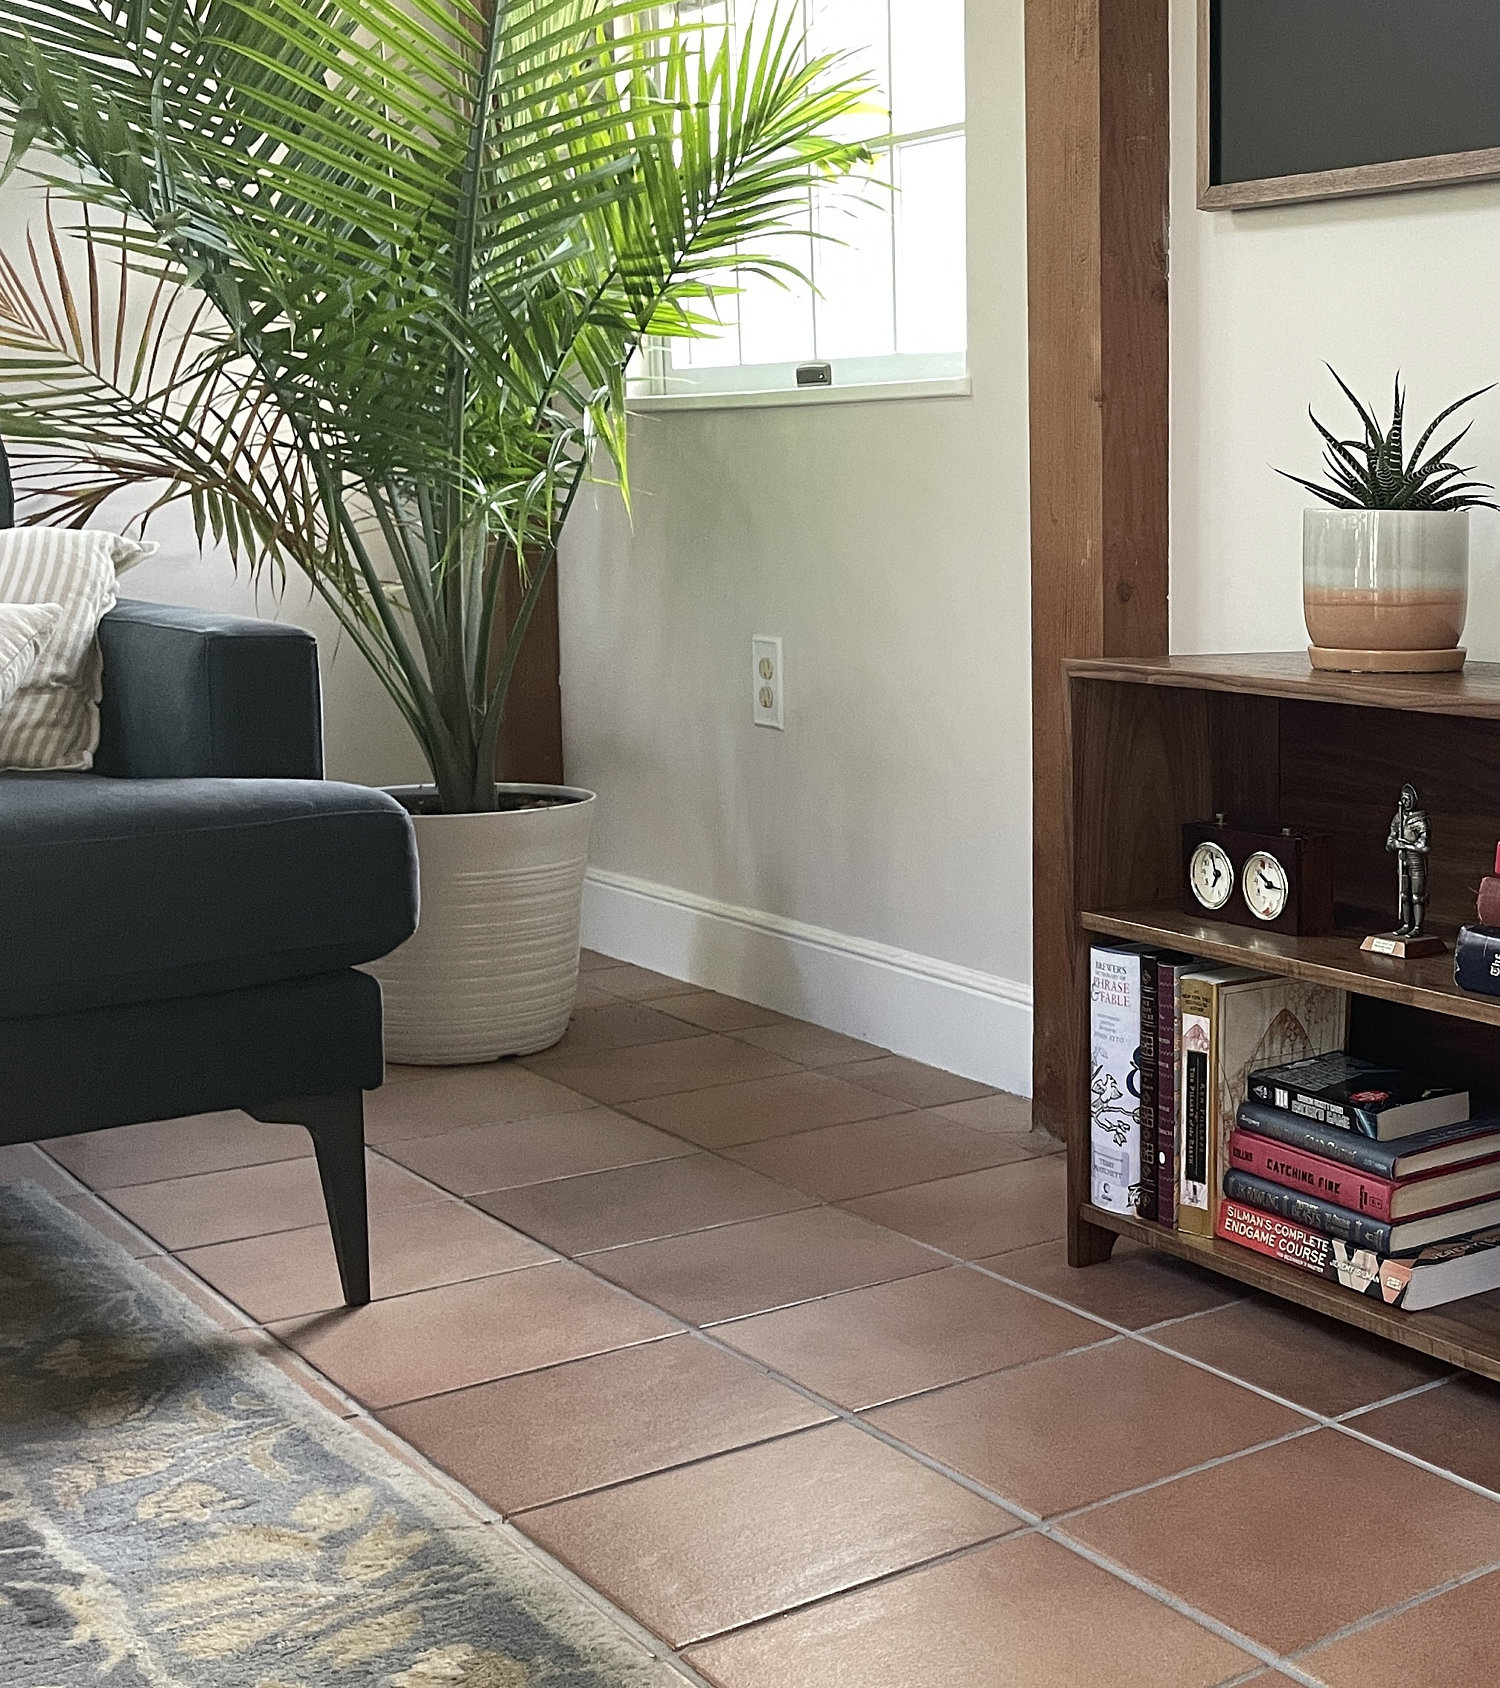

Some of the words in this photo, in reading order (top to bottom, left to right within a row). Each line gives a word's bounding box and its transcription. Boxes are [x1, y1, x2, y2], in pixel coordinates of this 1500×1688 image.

[1094, 976, 1131, 995] PHRASE
[1100, 991, 1131, 1008] FABLE
[1266, 1158, 1315, 1186] CATCHING
[1317, 1177, 1341, 1195] FIRE
[1224, 1217, 1277, 1248] ENDGAME
[1278, 1239, 1327, 1268] COURSE
[1227, 1205, 1272, 1231] SILMAN'S
[1274, 1223, 1329, 1253] COMPLETE
[1329, 1259, 1354, 1273] JEREMY
[1356, 1268, 1380, 1284] SILMAN
